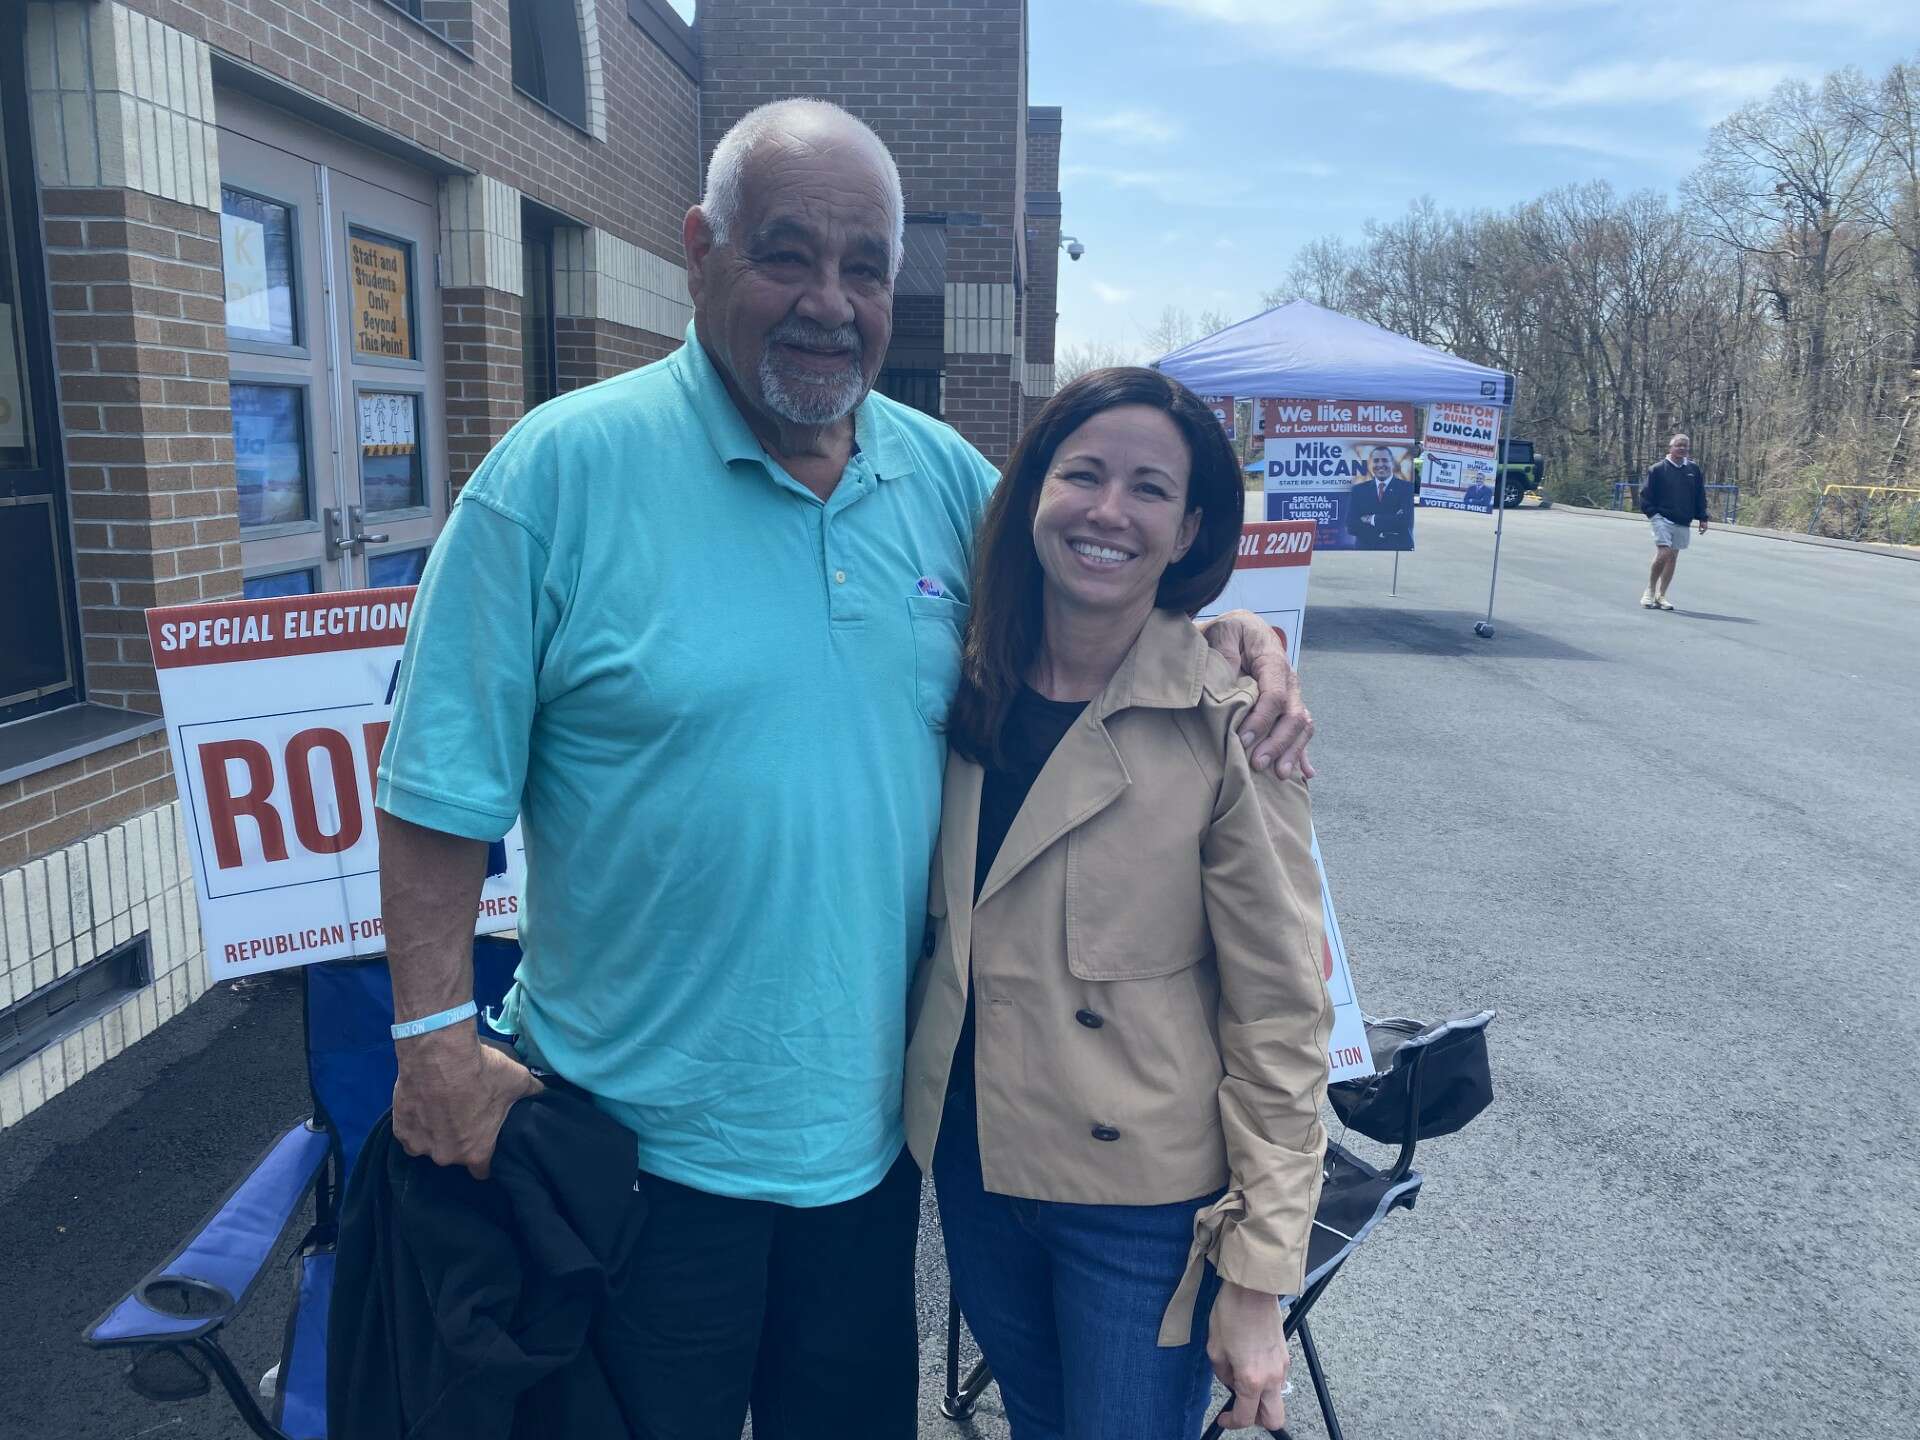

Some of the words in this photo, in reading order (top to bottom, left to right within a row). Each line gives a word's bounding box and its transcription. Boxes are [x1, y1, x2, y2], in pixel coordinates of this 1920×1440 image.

[352, 245, 378, 268] Staff
[380, 255, 398, 273] and
[355, 267, 397, 292] Students
[368, 290, 390, 314] Only
[363, 310, 397, 334] Beyond
[358, 332, 379, 352] This
[381, 335, 404, 356] Point
[1278, 405, 1312, 423] We
[1317, 405, 1352, 422] like
[1357, 405, 1404, 423] Mike
[1443, 412, 1473, 425] RUNS
[1476, 418, 1493, 428] ON
[1275, 423, 1291, 434] for
[1294, 424, 1329, 433] Lower
[1331, 423, 1373, 433] Utilities
[1374, 424, 1408, 434] Costs!
[1432, 421, 1493, 441] DUNCAN
[1295, 442, 1343, 459] Mike
[1268, 459, 1369, 478] DUNCAN
[1289, 502, 1332, 510] ELECTION
[1292, 495, 1329, 503] SPECIAL
[1425, 499, 1447, 509] VOTE
[1448, 502, 1466, 510] FOR
[1467, 504, 1488, 513] MIKE
[1289, 511, 1331, 519] TUESDAY,
[1318, 517, 1329, 525] 22
[1238, 534, 1260, 556] RIL
[1263, 531, 1312, 555] 22ND
[160, 614, 274, 651] SPECIAL
[284, 601, 408, 640] ELECTION
[224, 923, 345, 964] REPUBLICAN
[350, 917, 384, 943] FOR
[477, 895, 518, 919] PRES
[1328, 1045, 1364, 1069] LTON
